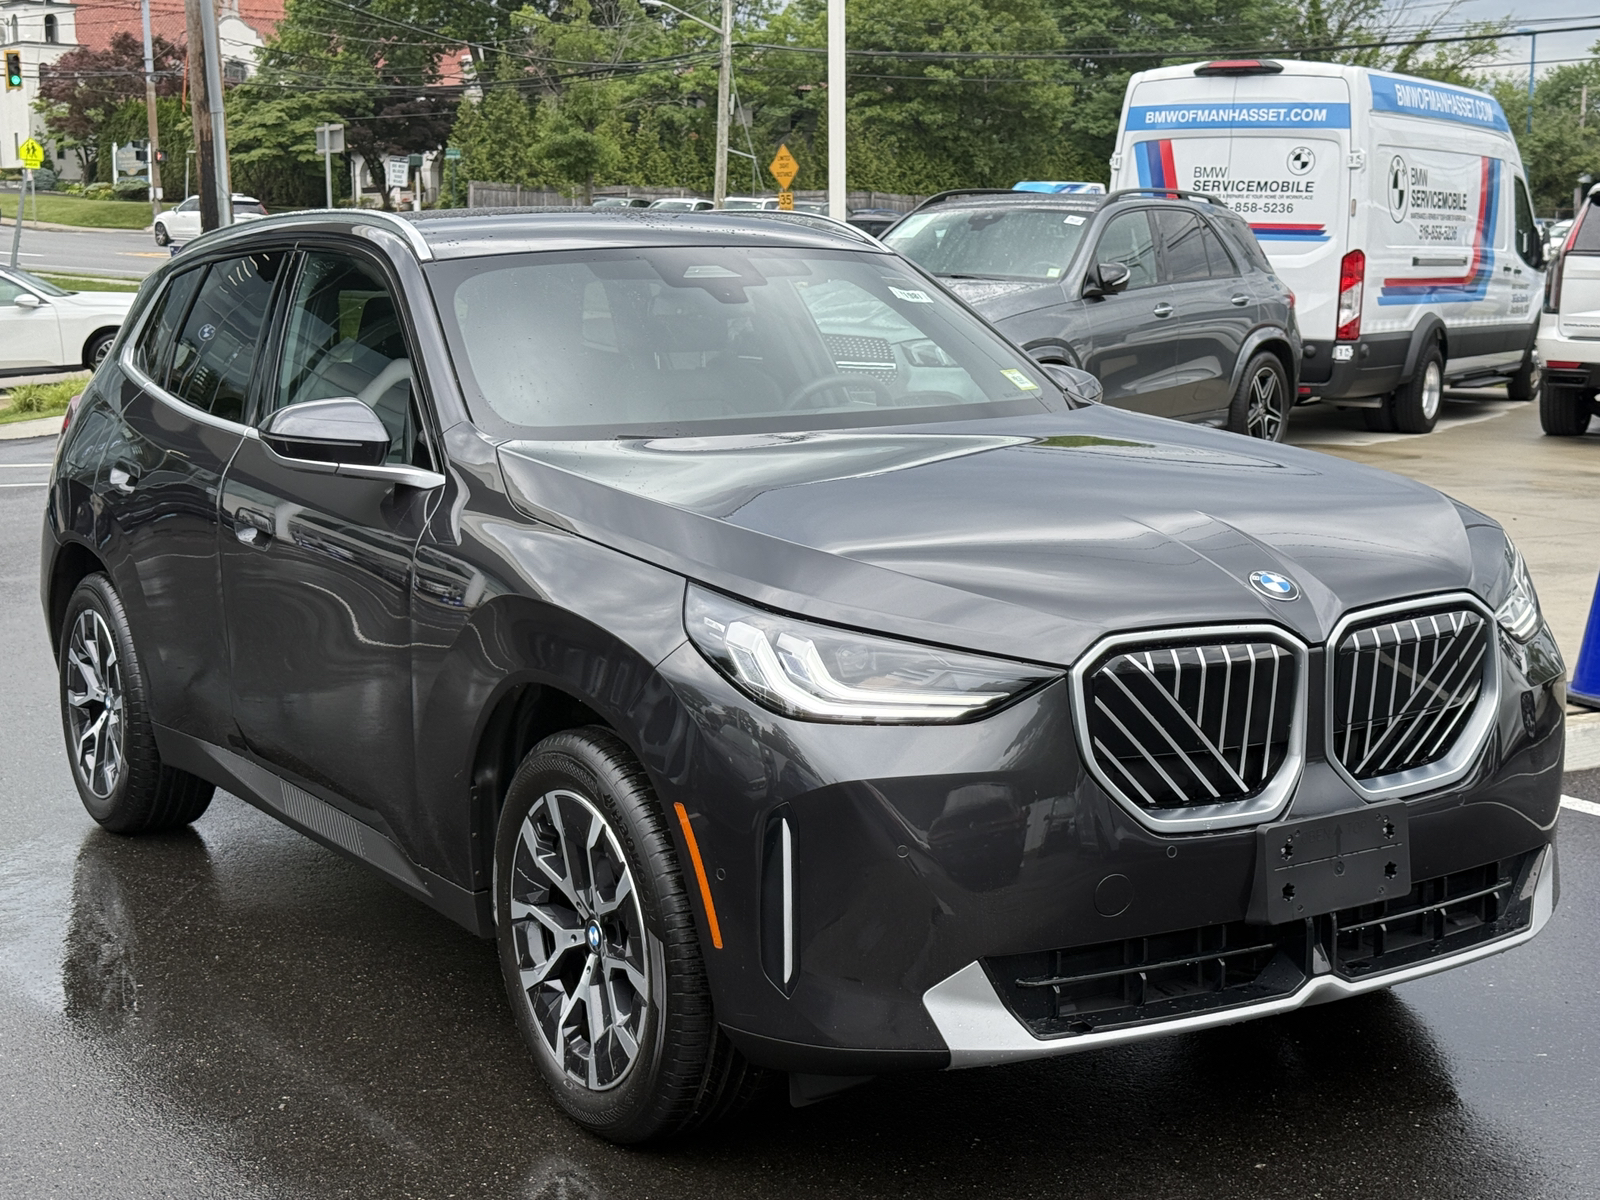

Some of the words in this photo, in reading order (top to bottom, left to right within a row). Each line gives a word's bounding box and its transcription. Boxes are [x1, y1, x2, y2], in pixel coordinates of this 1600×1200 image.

[1394, 84, 1494, 122] BMWOFMANHASSET.COM
[1145, 108, 1328, 124] BMWOFMANHASSET.COM
[1193, 166, 1228, 179] BMW
[1410, 167, 1428, 188] BMW
[1192, 179, 1315, 193] SERVICEMOBILE
[780, 194, 792, 205] 35
[1410, 189, 1468, 211] SERVICEMOBILE
